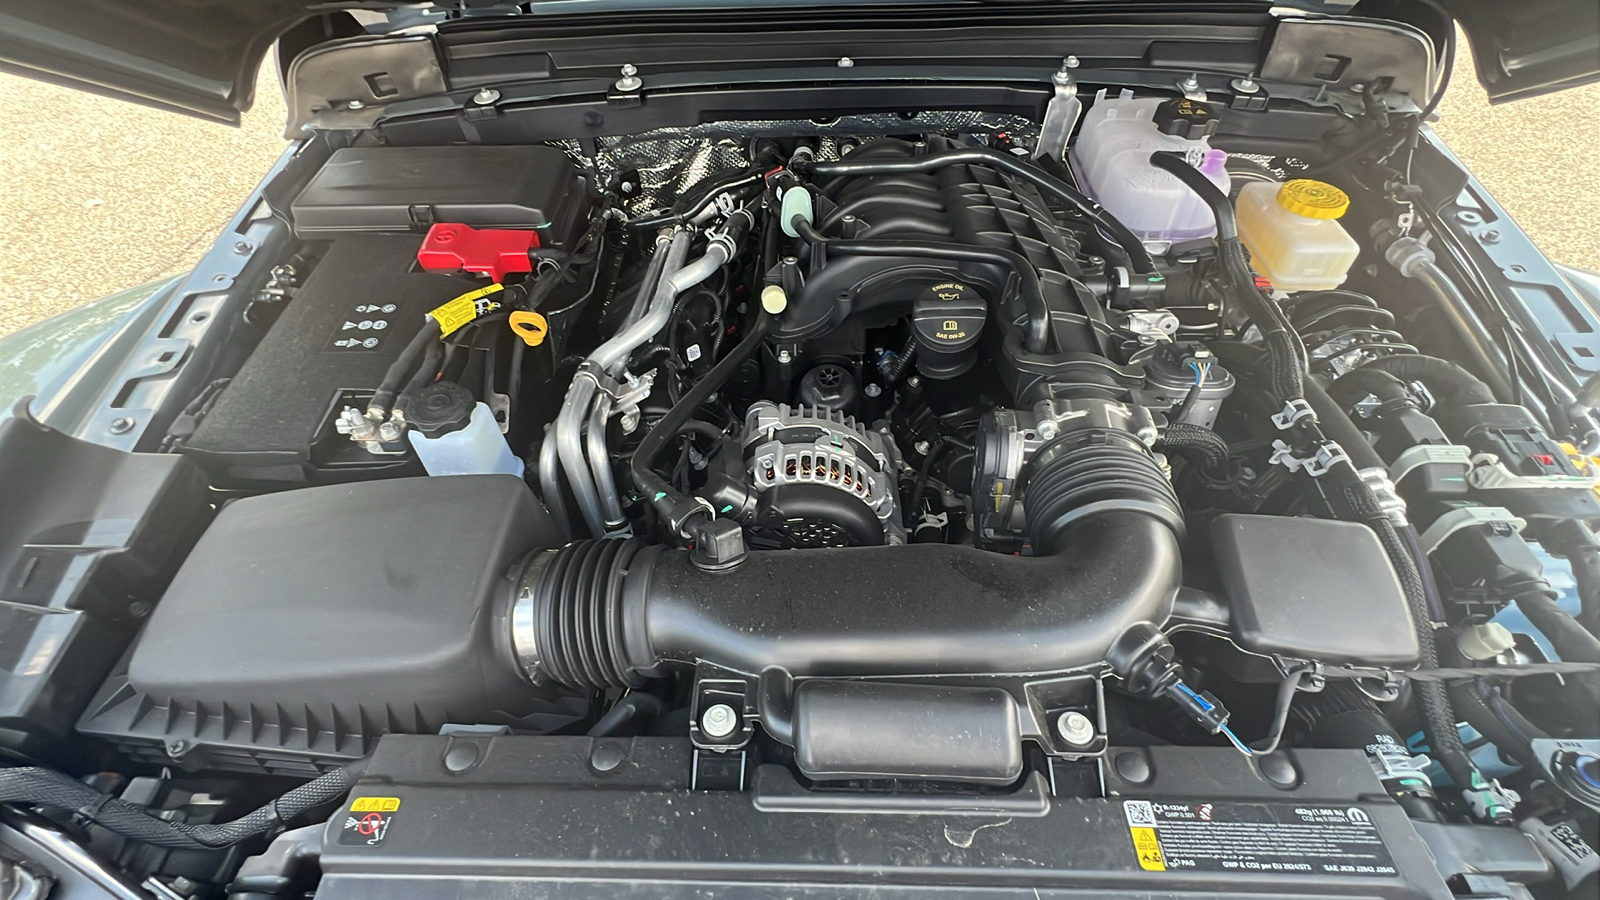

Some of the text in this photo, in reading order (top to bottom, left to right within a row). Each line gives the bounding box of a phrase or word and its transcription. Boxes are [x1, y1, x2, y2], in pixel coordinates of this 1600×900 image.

[932, 284, 953, 292] ENGINE
[1375, 734, 1395, 744] RAD
[1323, 864, 1339, 872] SAE
